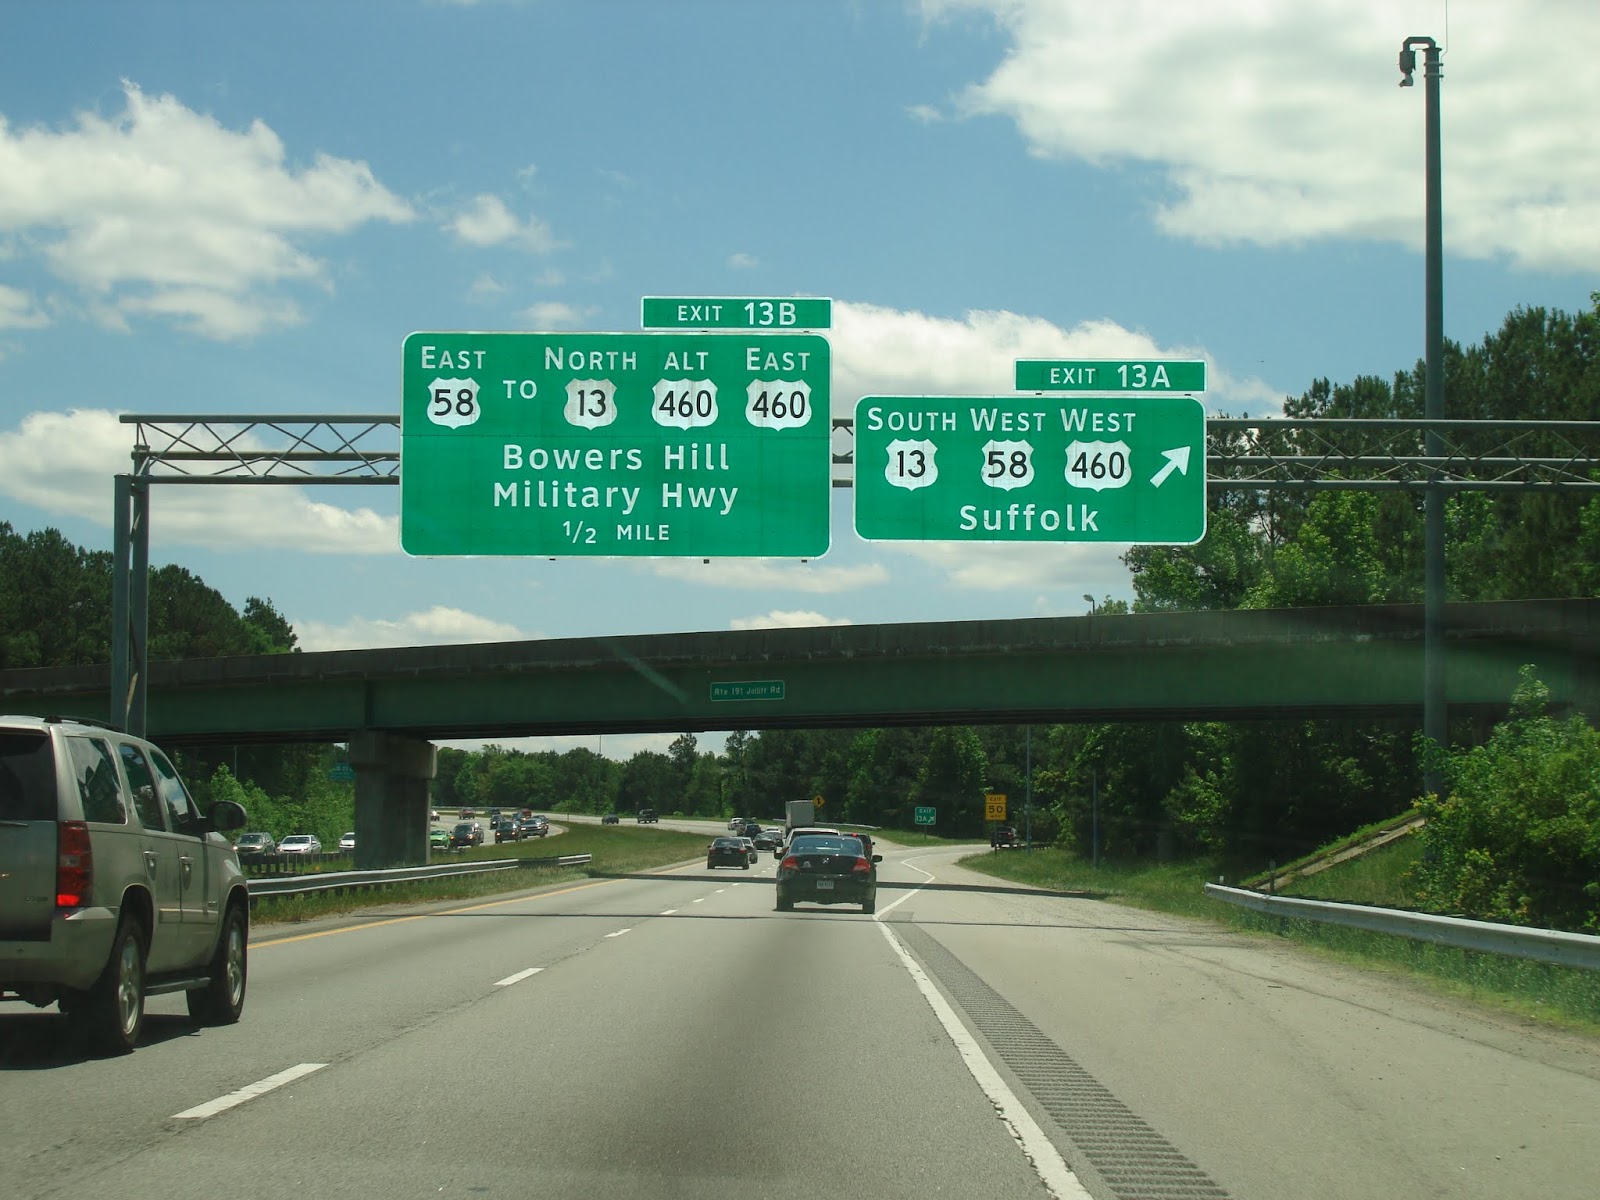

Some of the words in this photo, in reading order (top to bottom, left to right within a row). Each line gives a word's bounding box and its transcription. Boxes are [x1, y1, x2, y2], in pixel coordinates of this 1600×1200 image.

[677, 305, 723, 322] EXIT
[744, 302, 797, 326] 13B
[421, 346, 486, 370] EAST
[544, 347, 637, 371] NORTH
[663, 351, 709, 371] ALT
[746, 347, 811, 371] EAST
[1050, 367, 1096, 384] EXIT
[1117, 365, 1171, 388] 13A
[433, 388, 475, 417] 58
[502, 380, 538, 399] TO
[577, 389, 607, 418] 13
[658, 389, 712, 418] 460
[752, 390, 806, 419] 460
[867, 406, 957, 432] SOUTH
[969, 408, 1046, 432] WEST
[1060, 408, 1137, 433] WEST
[503, 444, 643, 471] Bowers
[664, 442, 729, 471] Hill
[896, 449, 926, 478] 13
[986, 450, 1028, 479] 58
[1071, 451, 1126, 480] 460
[493, 480, 641, 515] Military
[662, 482, 739, 516] Hwy
[959, 503, 1099, 532] Suffolk
[562, 520, 597, 545] 1/2
[617, 524, 670, 541] MILE
[714, 688, 728, 696] Rte
[731, 687, 743, 695] 191
[770, 685, 781, 694] Rd
[988, 805, 1003, 814] 50
